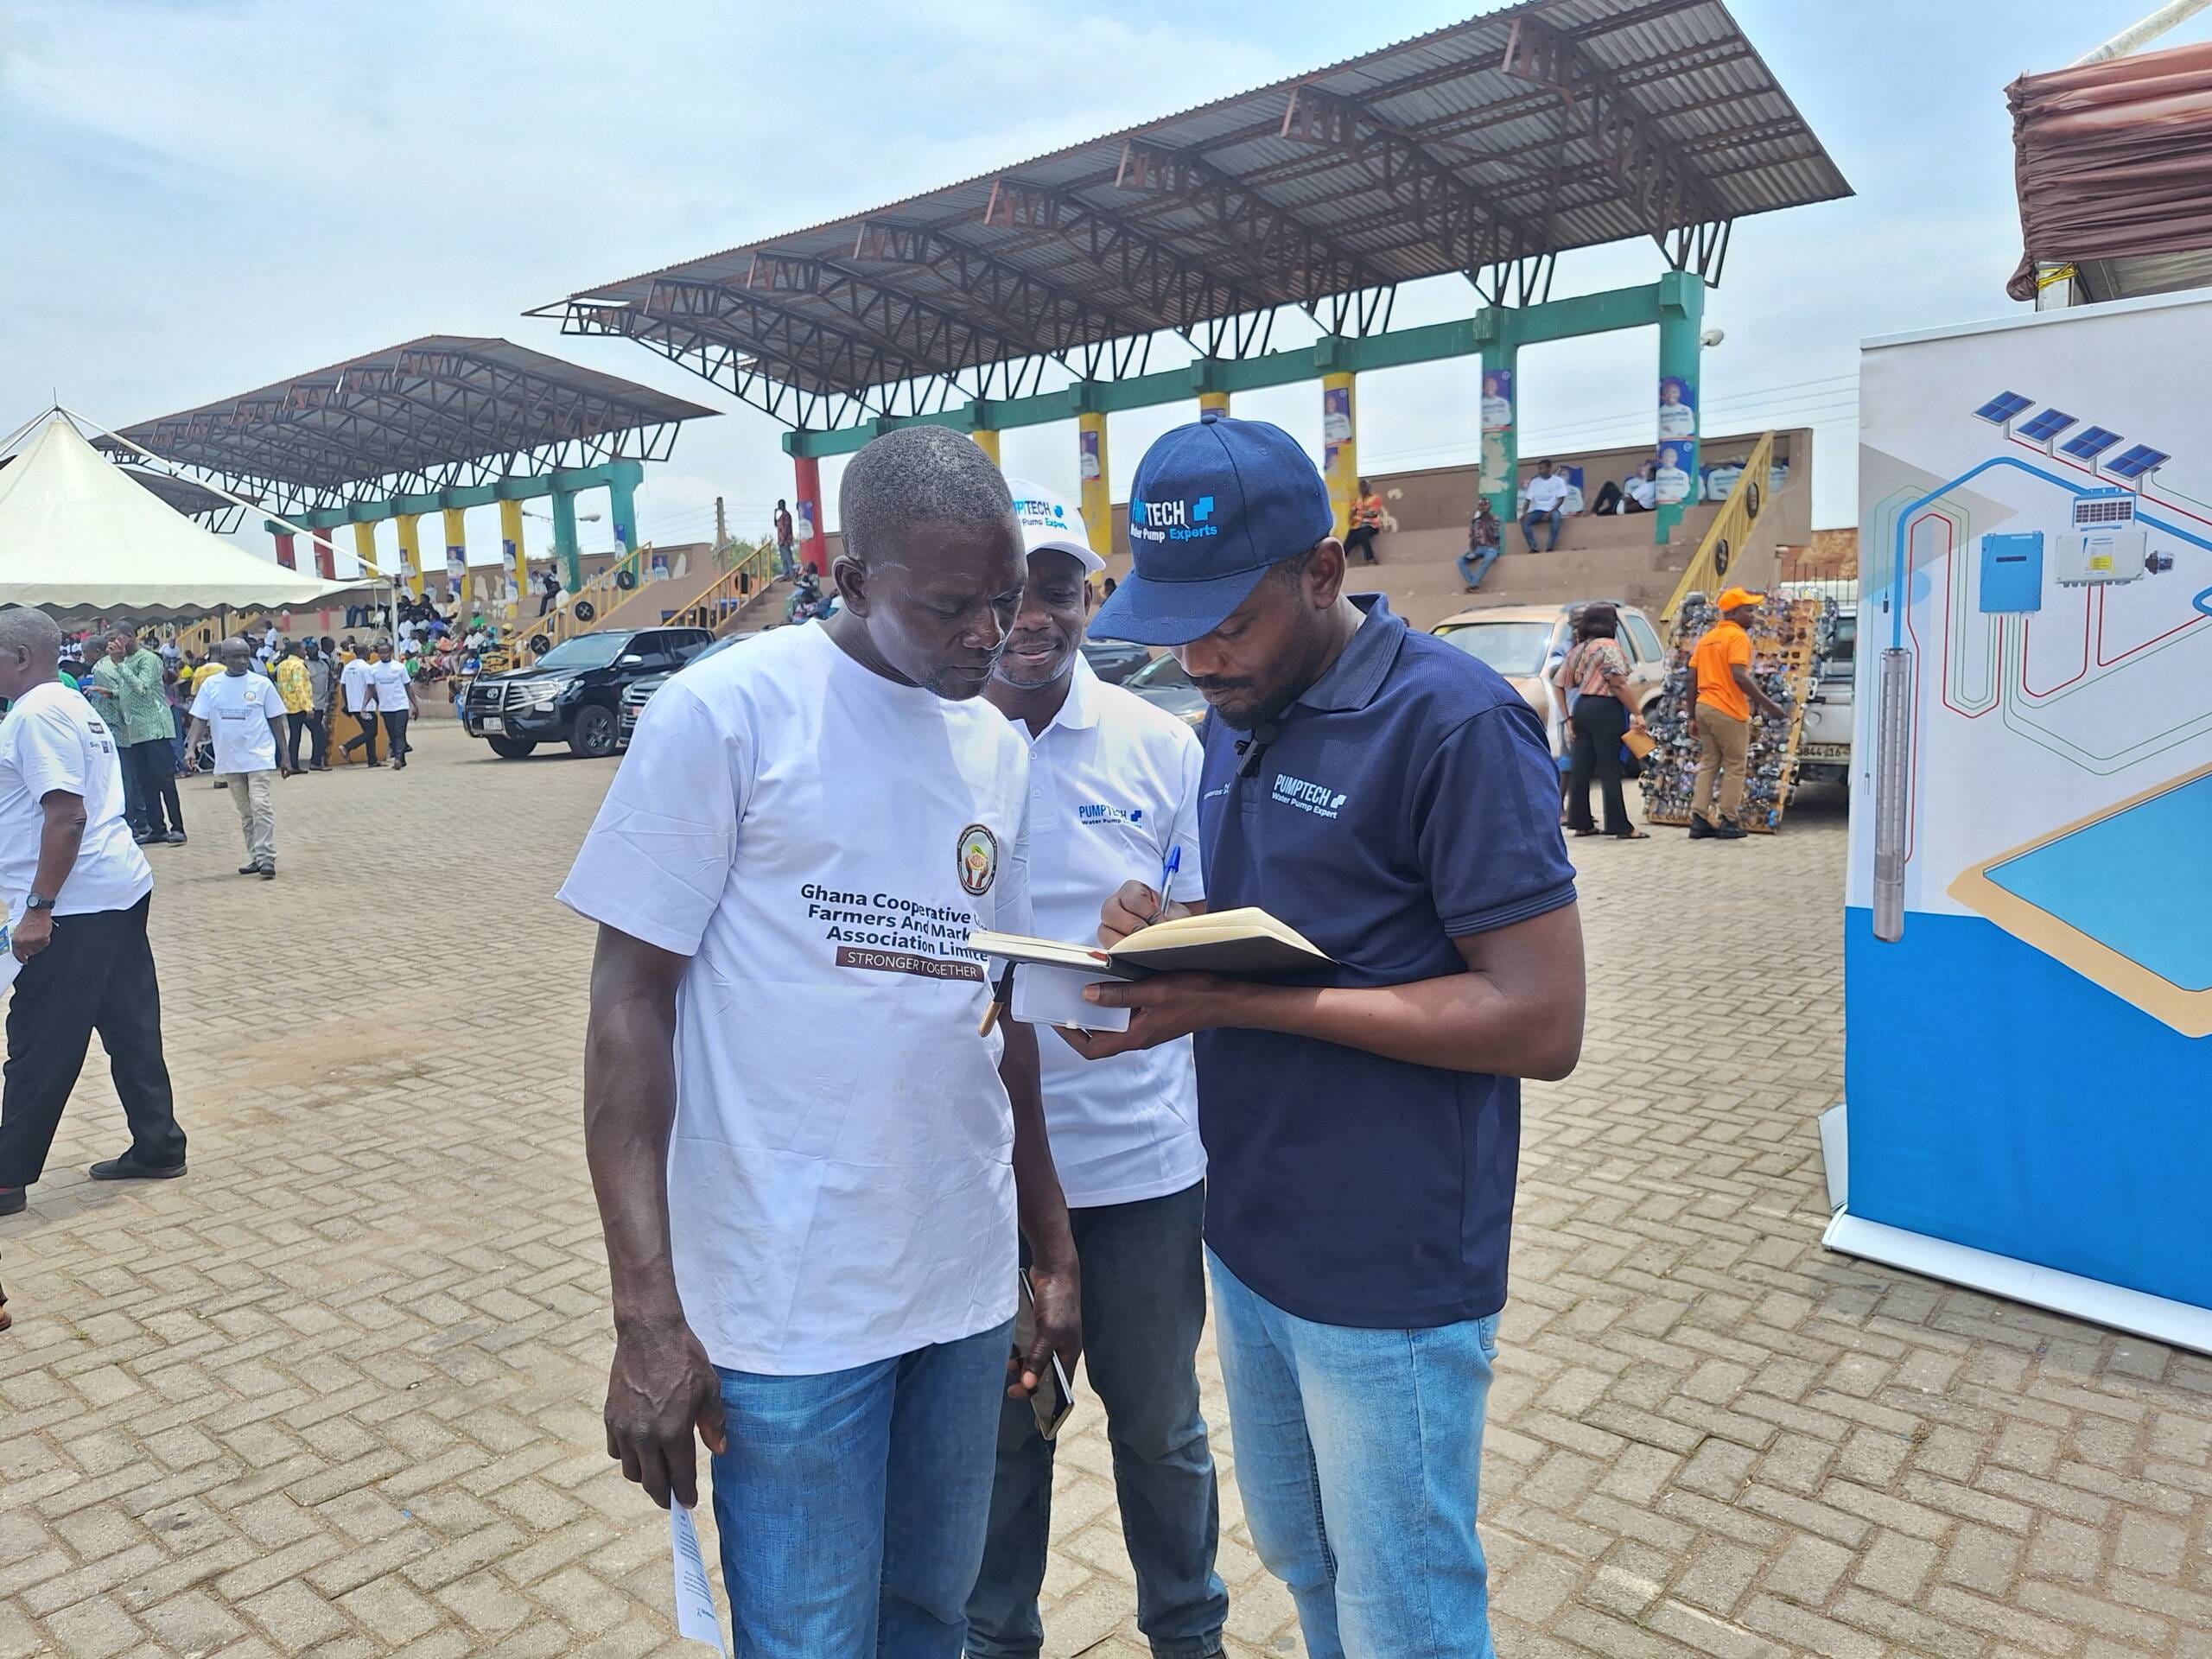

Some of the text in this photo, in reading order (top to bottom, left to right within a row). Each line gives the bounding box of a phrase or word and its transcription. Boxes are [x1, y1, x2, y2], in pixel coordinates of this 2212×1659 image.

[1142, 528, 1166, 543] Pump
[1169, 524, 1217, 542] Experts
[1274, 773, 1332, 806] PUMPTECH
[1272, 791, 1338, 820] Water Pump Expert
[801, 884, 868, 906] Ghana
[873, 893, 971, 924] Cooperative
[808, 904, 971, 942] Farmers And Mark
[826, 925, 936, 954] Association
